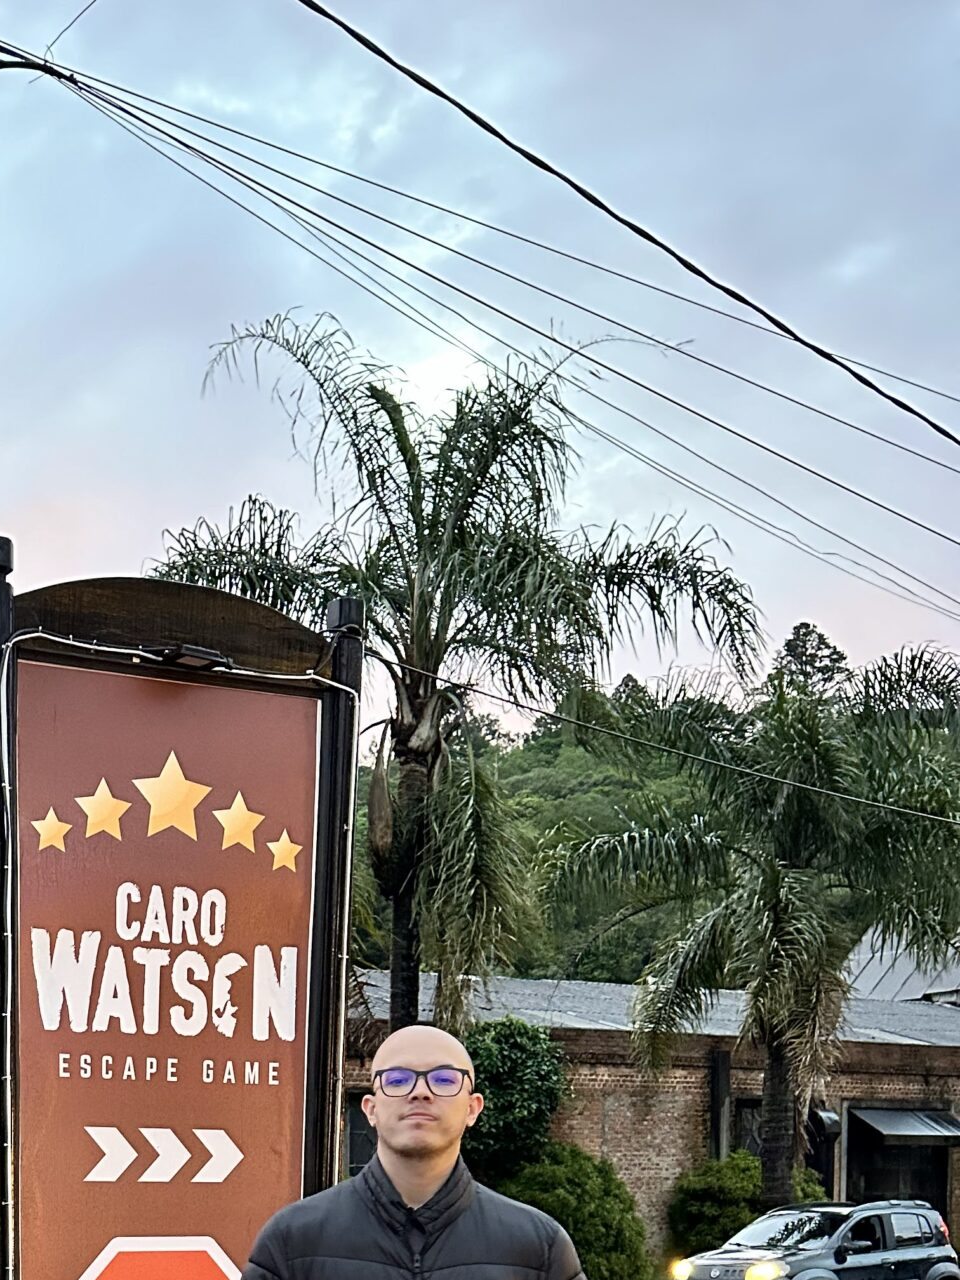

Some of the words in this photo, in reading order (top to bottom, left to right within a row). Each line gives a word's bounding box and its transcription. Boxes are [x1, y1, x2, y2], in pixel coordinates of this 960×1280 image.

[115, 882, 227, 947] CARO
[58, 1053, 178, 1082] ESCAPE
[202, 1059, 280, 1086] GAME
